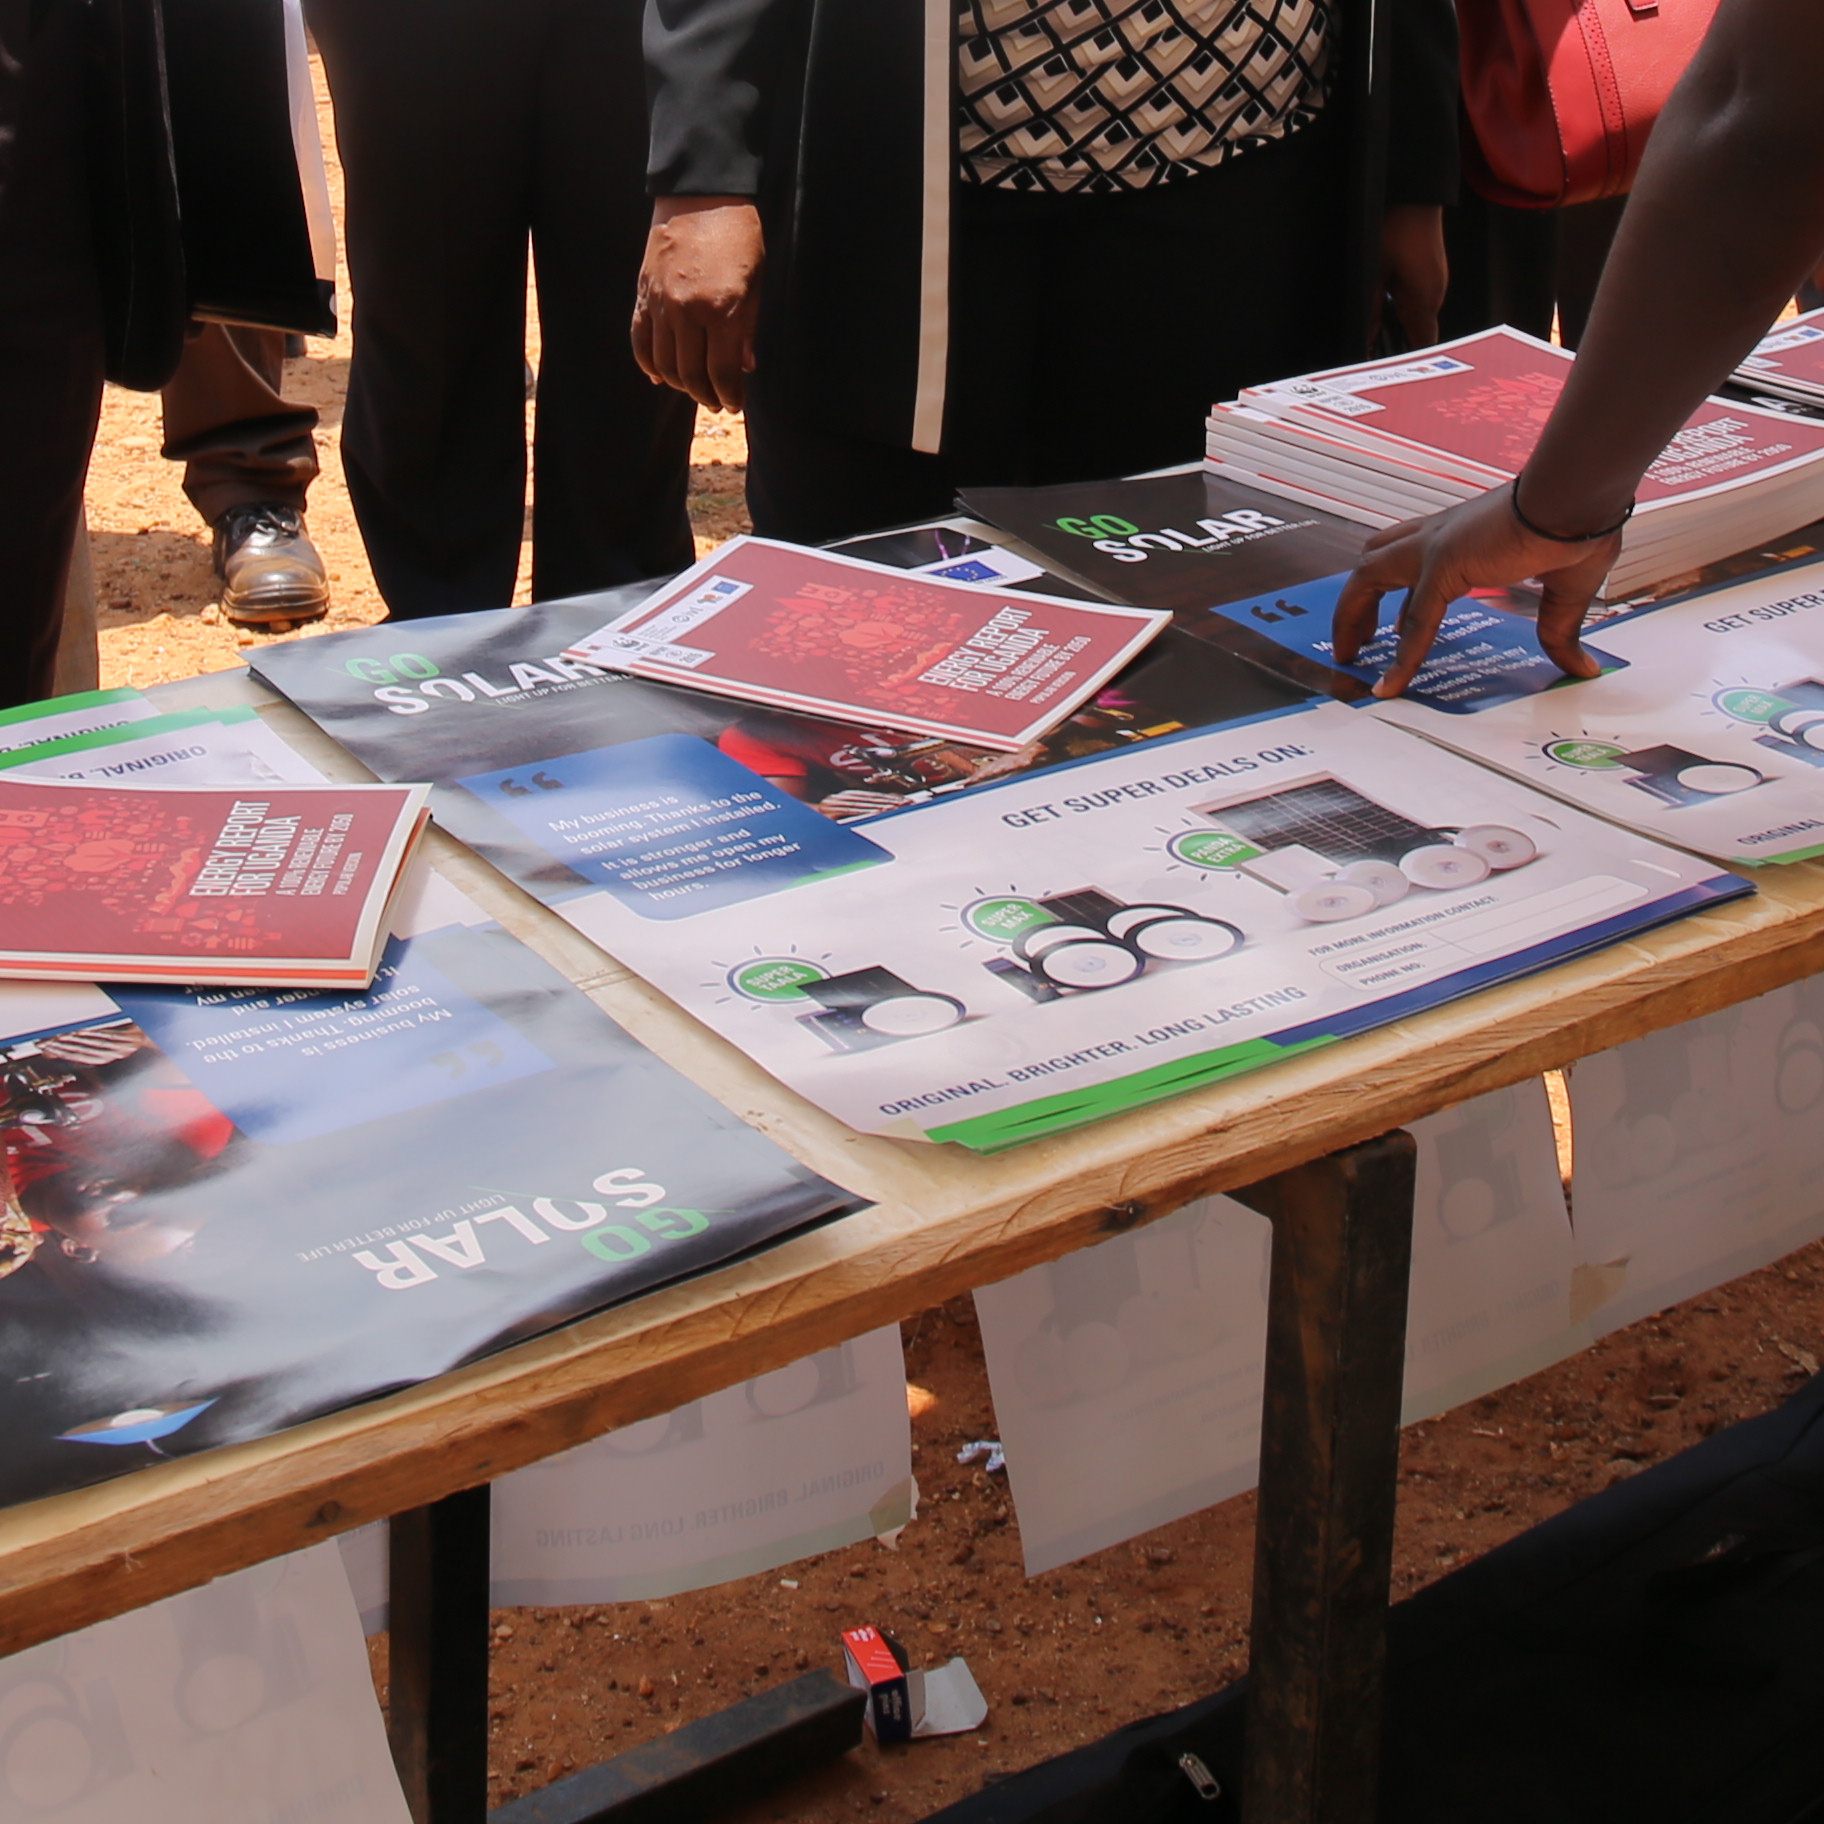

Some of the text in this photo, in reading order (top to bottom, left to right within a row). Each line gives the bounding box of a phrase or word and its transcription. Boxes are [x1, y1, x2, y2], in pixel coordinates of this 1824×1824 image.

[1056, 514, 1139, 539] GO
[1093, 508, 1285, 563] SOLAR
[1703, 614, 1753, 633] GET
[917, 605, 1032, 686] ENERGY REPORT
[948, 626, 1050, 692] FOR UGANDA
[345, 653, 440, 685] GO
[374, 657, 608, 715] SOLAR
[495, 692, 532, 706] LIGHT
[534, 687, 549, 697] UP
[551, 682, 576, 694] FOR
[88, 744, 208, 777] ORIGINAL.
[1001, 743, 1315, 829] GET SUPER DEALS ON:
[548, 795, 679, 833] My business is
[563, 790, 763, 844] booming. Thanks to the
[580, 837, 624, 856] solar
[629, 821, 695, 844] system
[703, 802, 782, 825] installed.
[189, 800, 271, 896] ENERGY REPORT
[228, 816, 302, 896] FOR UGANDA
[601, 828, 752, 871] It is stronger and
[619, 833, 787, 881] allows me open my
[632, 841, 801, 891] business for longer
[1190, 837, 1234, 859] PANDA
[1206, 843, 1246, 863] EXTRA
[649, 881, 710, 902] hours.
[980, 902, 1023, 928] SUPER
[1001, 909, 1035, 930] MAX
[1308, 944, 1333, 957] FOR
[1333, 935, 1369, 951] MORE
[1368, 912, 1446, 941] INFORMATION
[745, 965, 794, 988] SUPER
[1336, 941, 1428, 972] ORGANISATION:
[371, 984, 421, 1006] solar
[1359, 968, 1401, 986] PHONE
[195, 994, 226, 1008] my
[232, 999, 270, 1017] and
[297, 999, 367, 1027] system
[185, 1021, 280, 1052] installed.
[203, 995, 438, 1065] booming. Thanks to the
[301, 1007, 453, 1058] My business is
[878, 985, 1309, 1117] ORIGINAL. BRIGHTER. LONG LASTING
[296, 1193, 506, 1262] LIGHT UP FOR BETTER LIFE
[351, 1167, 667, 1290] SOLAR
[581, 1207, 711, 1262] GO
